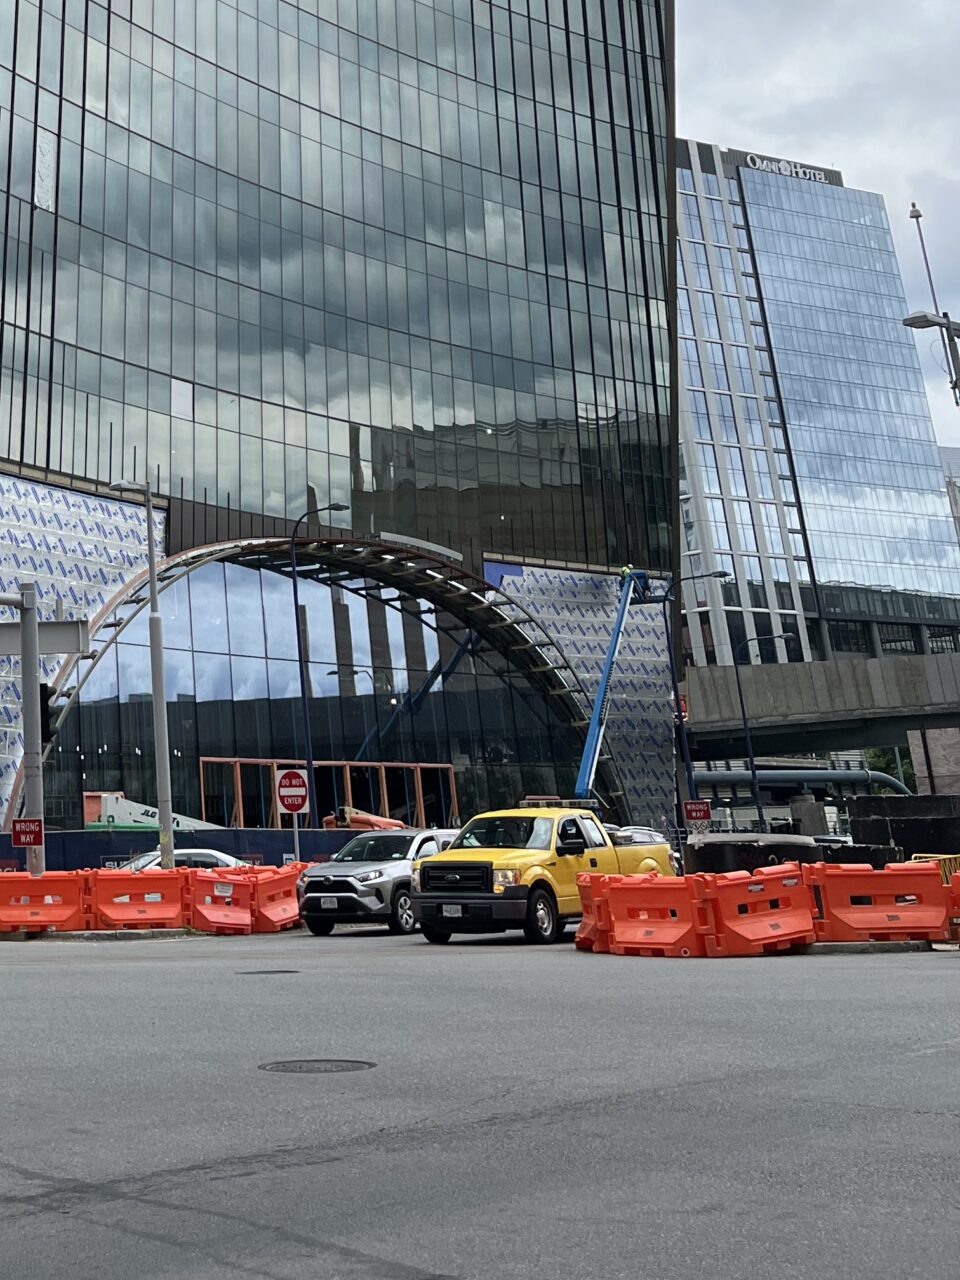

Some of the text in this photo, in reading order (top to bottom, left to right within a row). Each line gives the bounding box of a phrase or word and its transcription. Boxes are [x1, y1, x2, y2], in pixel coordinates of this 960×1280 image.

[746, 153, 829, 184] OMNI HOTEL
[281, 778, 303, 786] DO NOT
[284, 796, 302, 805] ENTER
[686, 803, 708, 811] WRONG
[140, 809, 158, 819] JLG
[15, 822, 40, 832] WRONG
[20, 833, 35, 843] WAY
